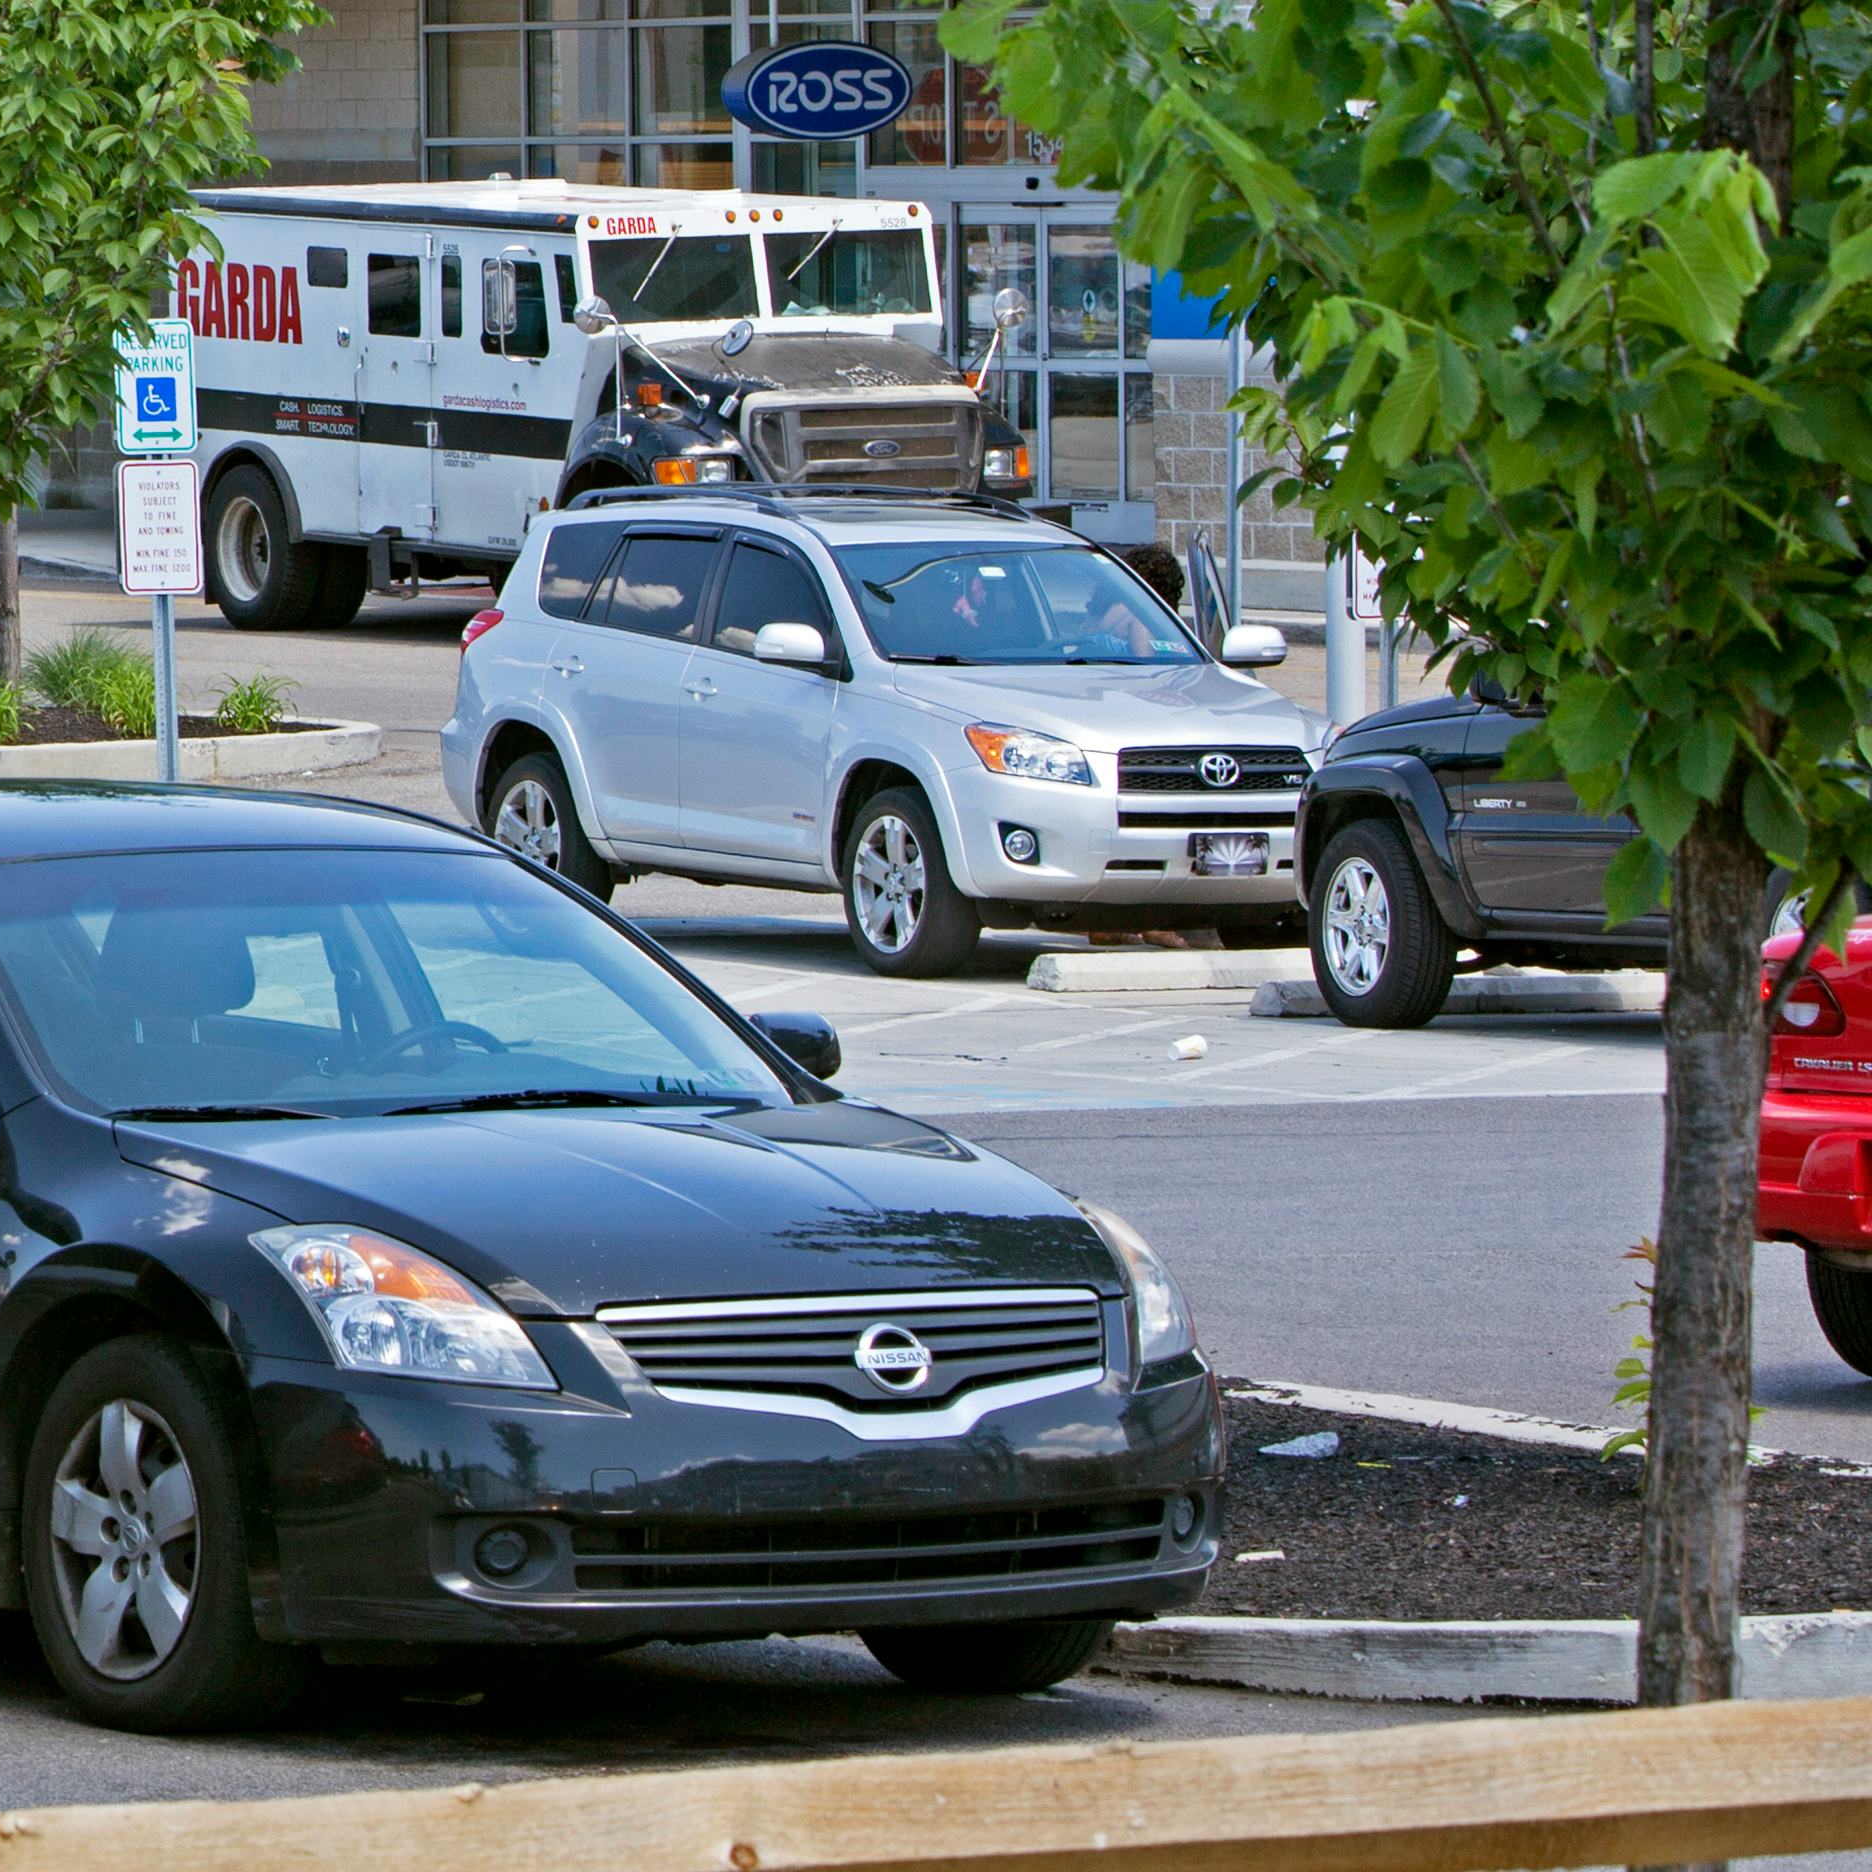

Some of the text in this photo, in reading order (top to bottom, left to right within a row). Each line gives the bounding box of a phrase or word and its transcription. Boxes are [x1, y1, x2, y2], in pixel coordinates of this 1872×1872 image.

[768, 69, 893, 114] ROSS
[606, 216, 658, 235] GARDA
[880, 217, 907, 229] 5528
[177, 258, 303, 344] GARDA
[443, 394, 527, 411] gardacashlogistics.com
[280, 400, 344, 417] CASH. LOGISTICS.
[138, 482, 181, 491] VIOLATORS
[142, 497, 177, 506] SUBJECT
[144, 512, 177, 521] TO FINE
[138, 526, 184, 535] AND TOWING
[153, 549, 169, 557] FINE
[151, 564, 168, 572] FINE
[1282, 774, 1303, 784] V6
[1473, 798, 1513, 808] LIBERTY
[1794, 1057, 1854, 1071] CAVALIER
[867, 1352, 928, 1364] NISSAN
